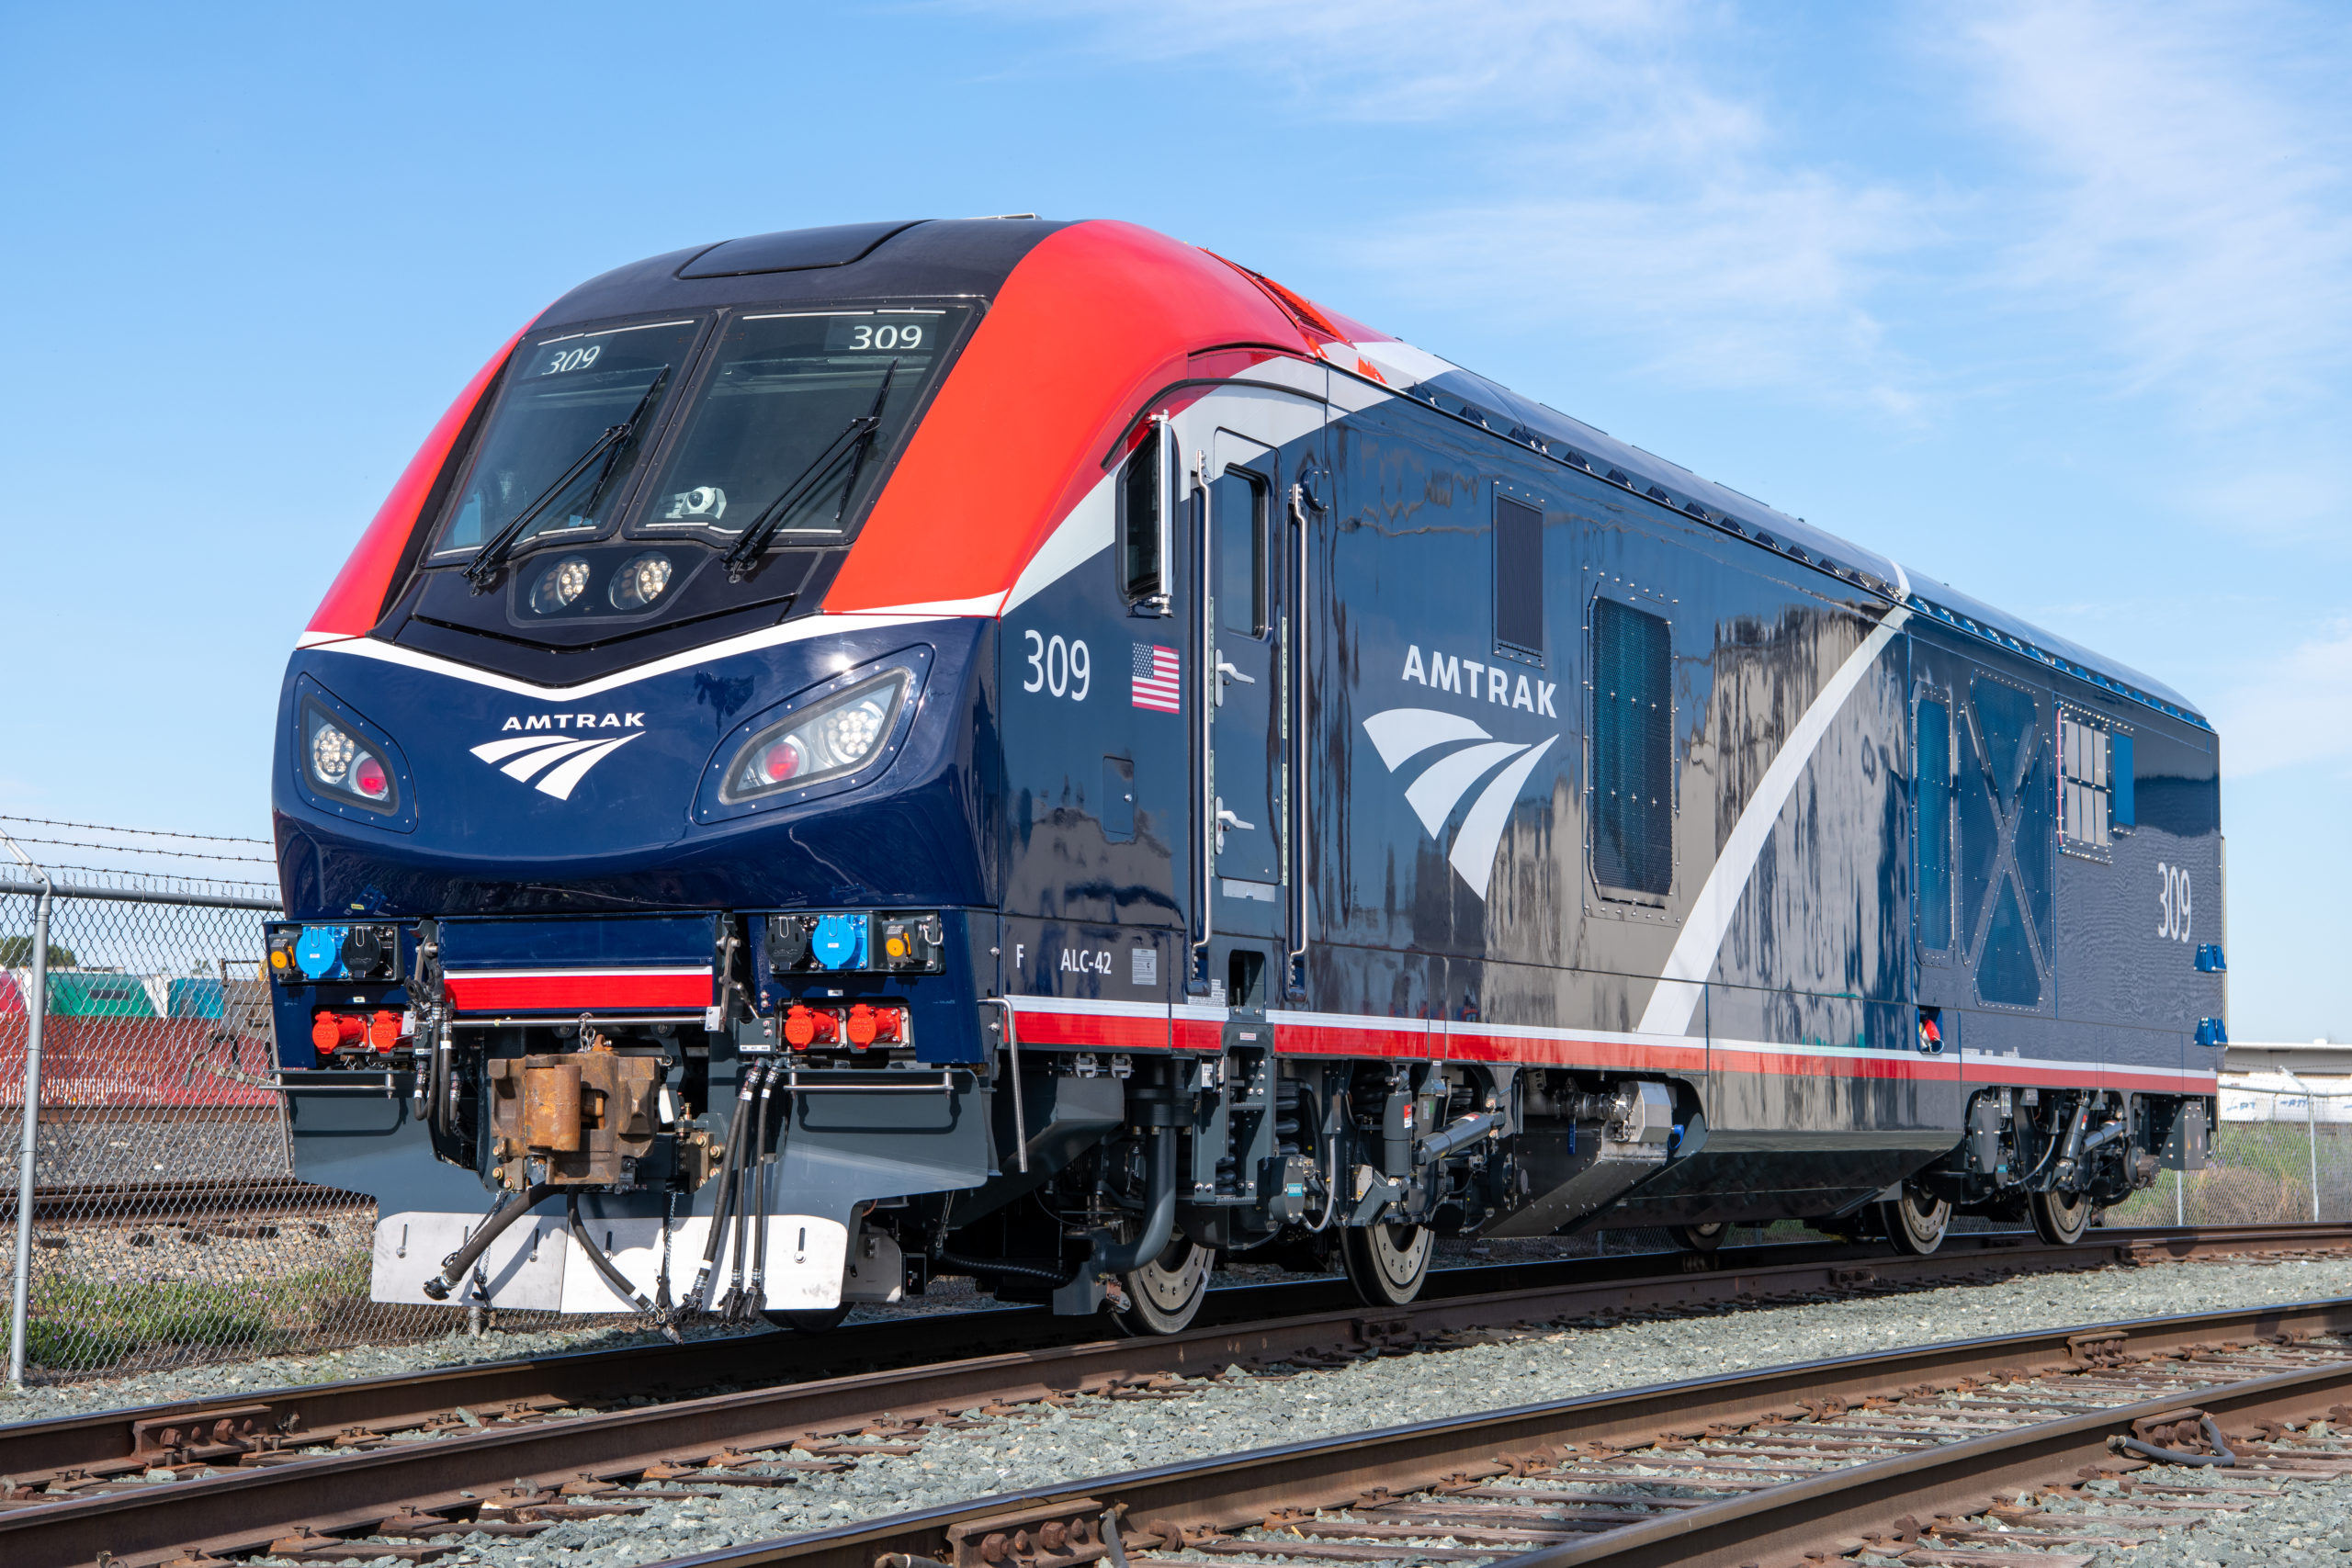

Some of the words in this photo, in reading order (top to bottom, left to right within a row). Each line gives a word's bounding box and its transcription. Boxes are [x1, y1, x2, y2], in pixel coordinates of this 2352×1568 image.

[849, 324, 922, 350] 309
[540, 344, 601, 376] 309
[1023, 629, 1091, 702] 309
[1401, 644, 1557, 719] AMTRAK
[501, 712, 646, 731] AMTRAK
[2157, 862, 2191, 943] 309
[1016, 943, 1024, 969] F
[1059, 948, 1112, 975] ALC-42
